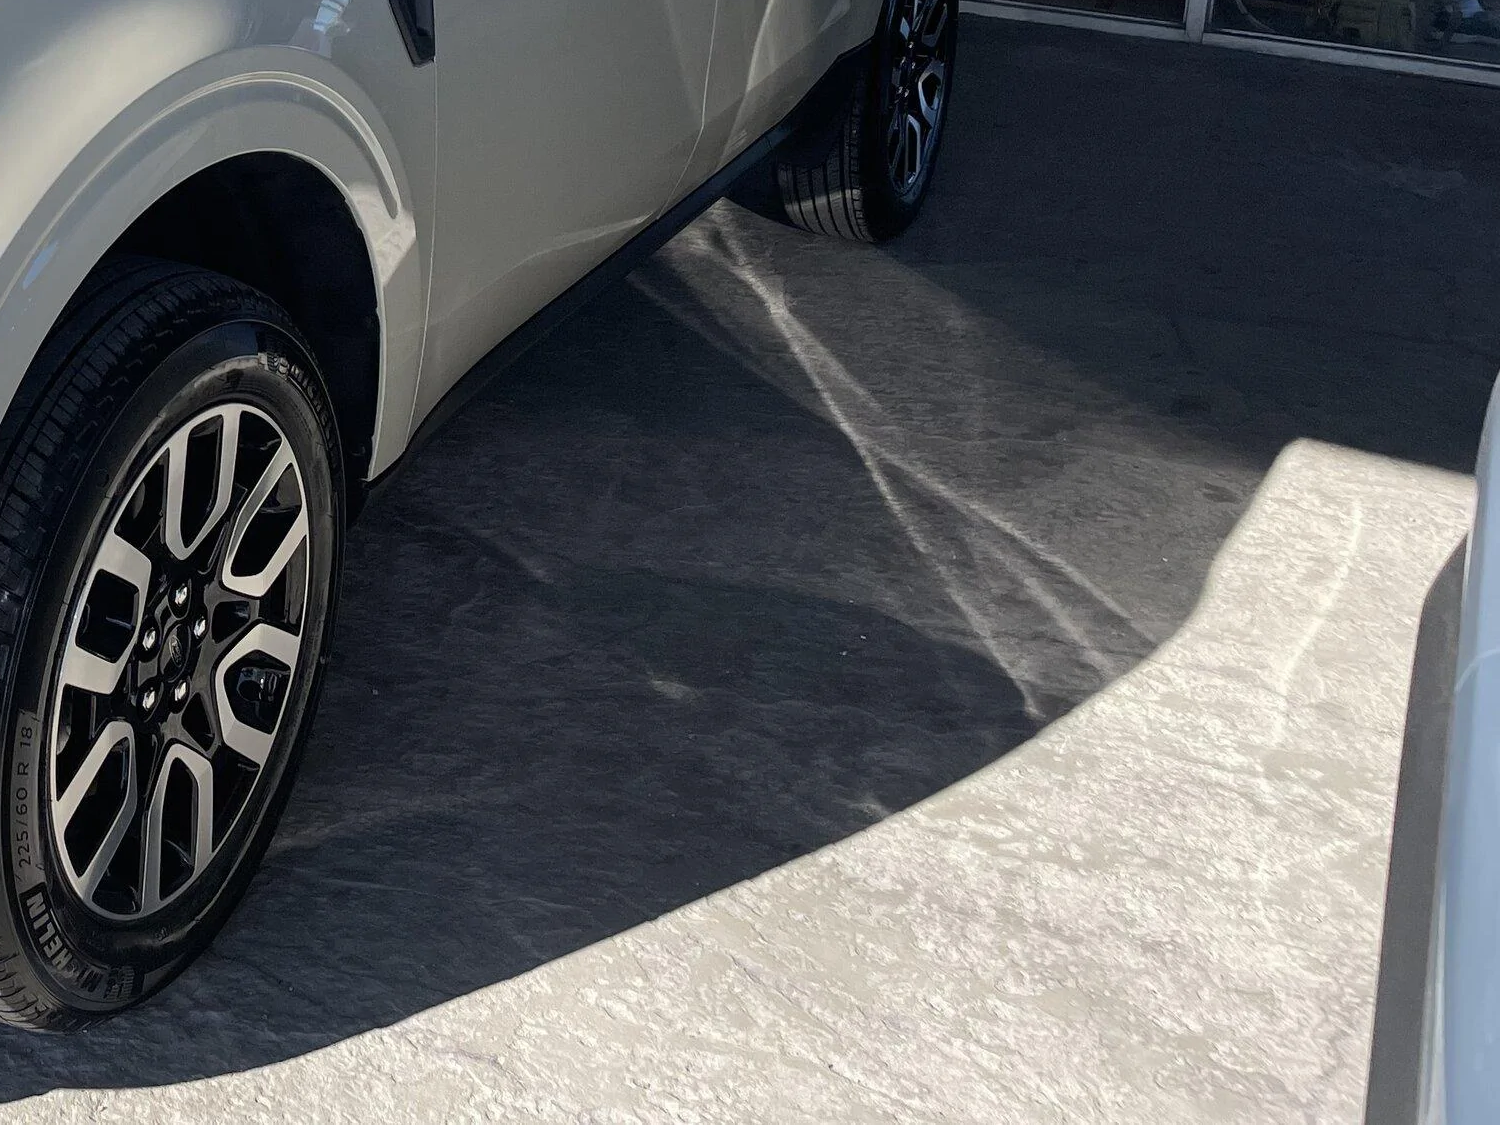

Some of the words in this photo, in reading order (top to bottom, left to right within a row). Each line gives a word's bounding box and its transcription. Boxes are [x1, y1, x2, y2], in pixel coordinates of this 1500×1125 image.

[19, 726, 33, 747] 18
[17, 762, 30, 776] R
[16, 787, 32, 869] 225/60
